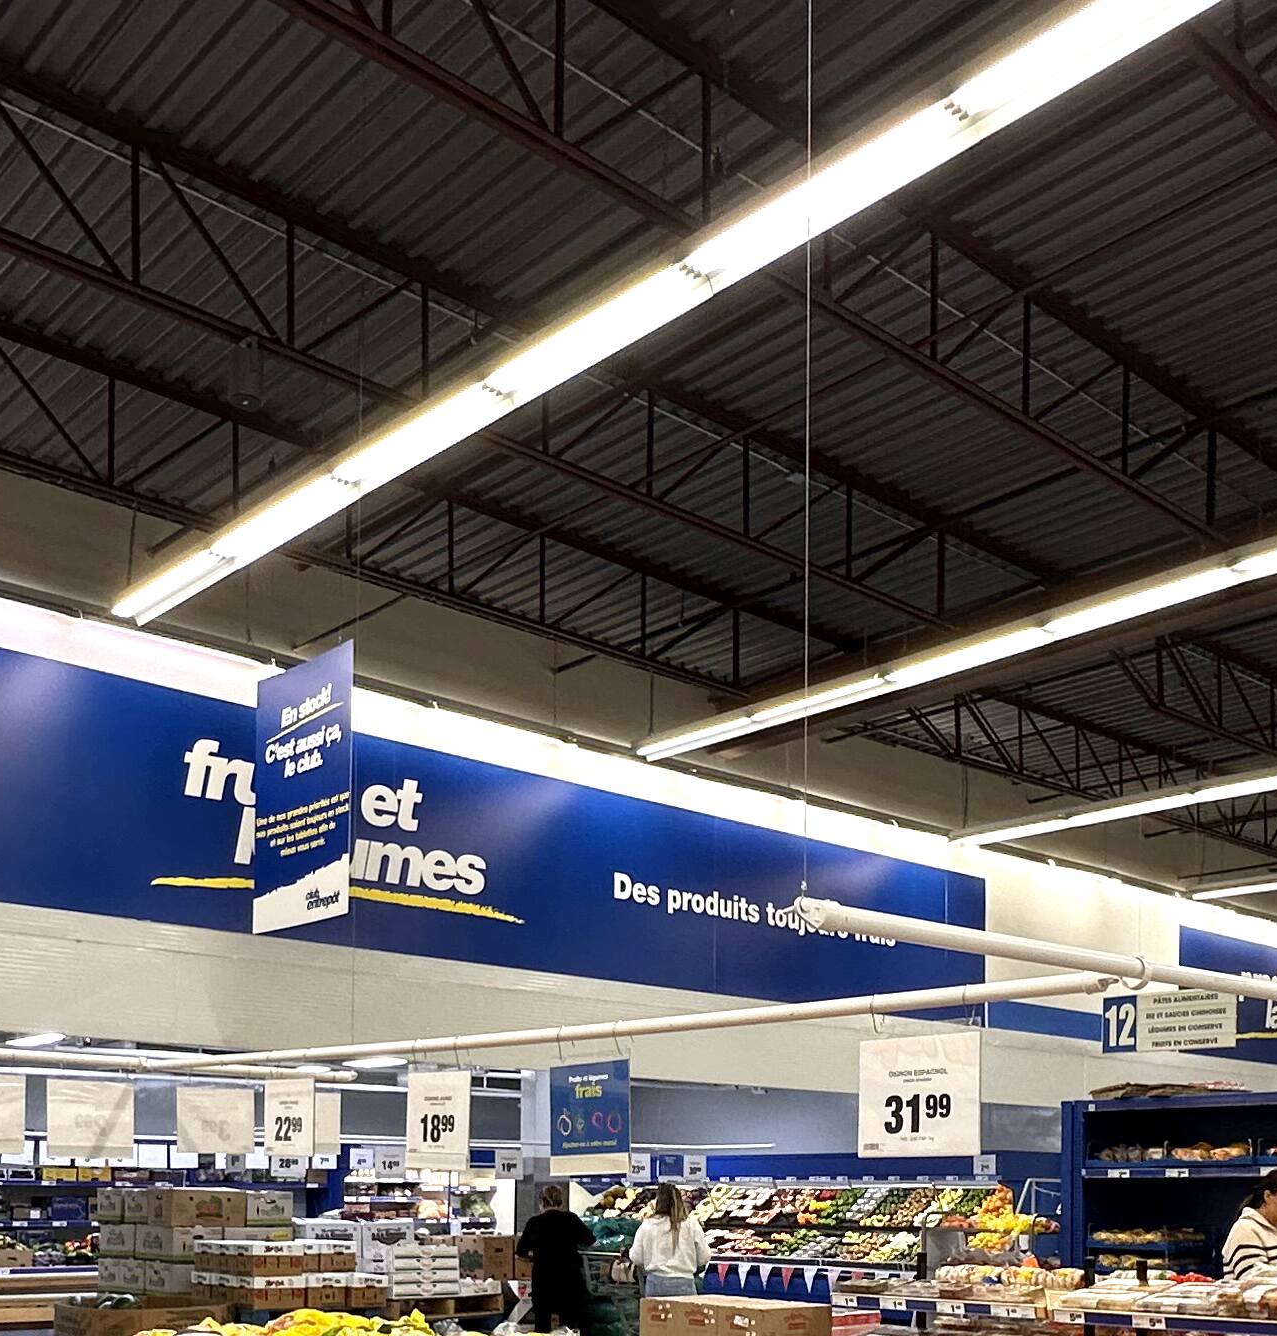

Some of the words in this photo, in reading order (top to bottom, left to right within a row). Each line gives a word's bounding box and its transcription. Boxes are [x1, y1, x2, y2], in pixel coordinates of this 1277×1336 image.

[281, 706, 298, 728] En
[265, 738, 295, 764] C'est
[295, 725, 326, 754] aussi
[284, 759, 296, 779] le
[297, 748, 323, 774] club.
[360, 778, 423, 832] et
[613, 871, 661, 906] Des
[667, 888, 760, 924] produits
[1105, 1003, 1135, 1048] 12
[574, 1081, 603, 1099] frais
